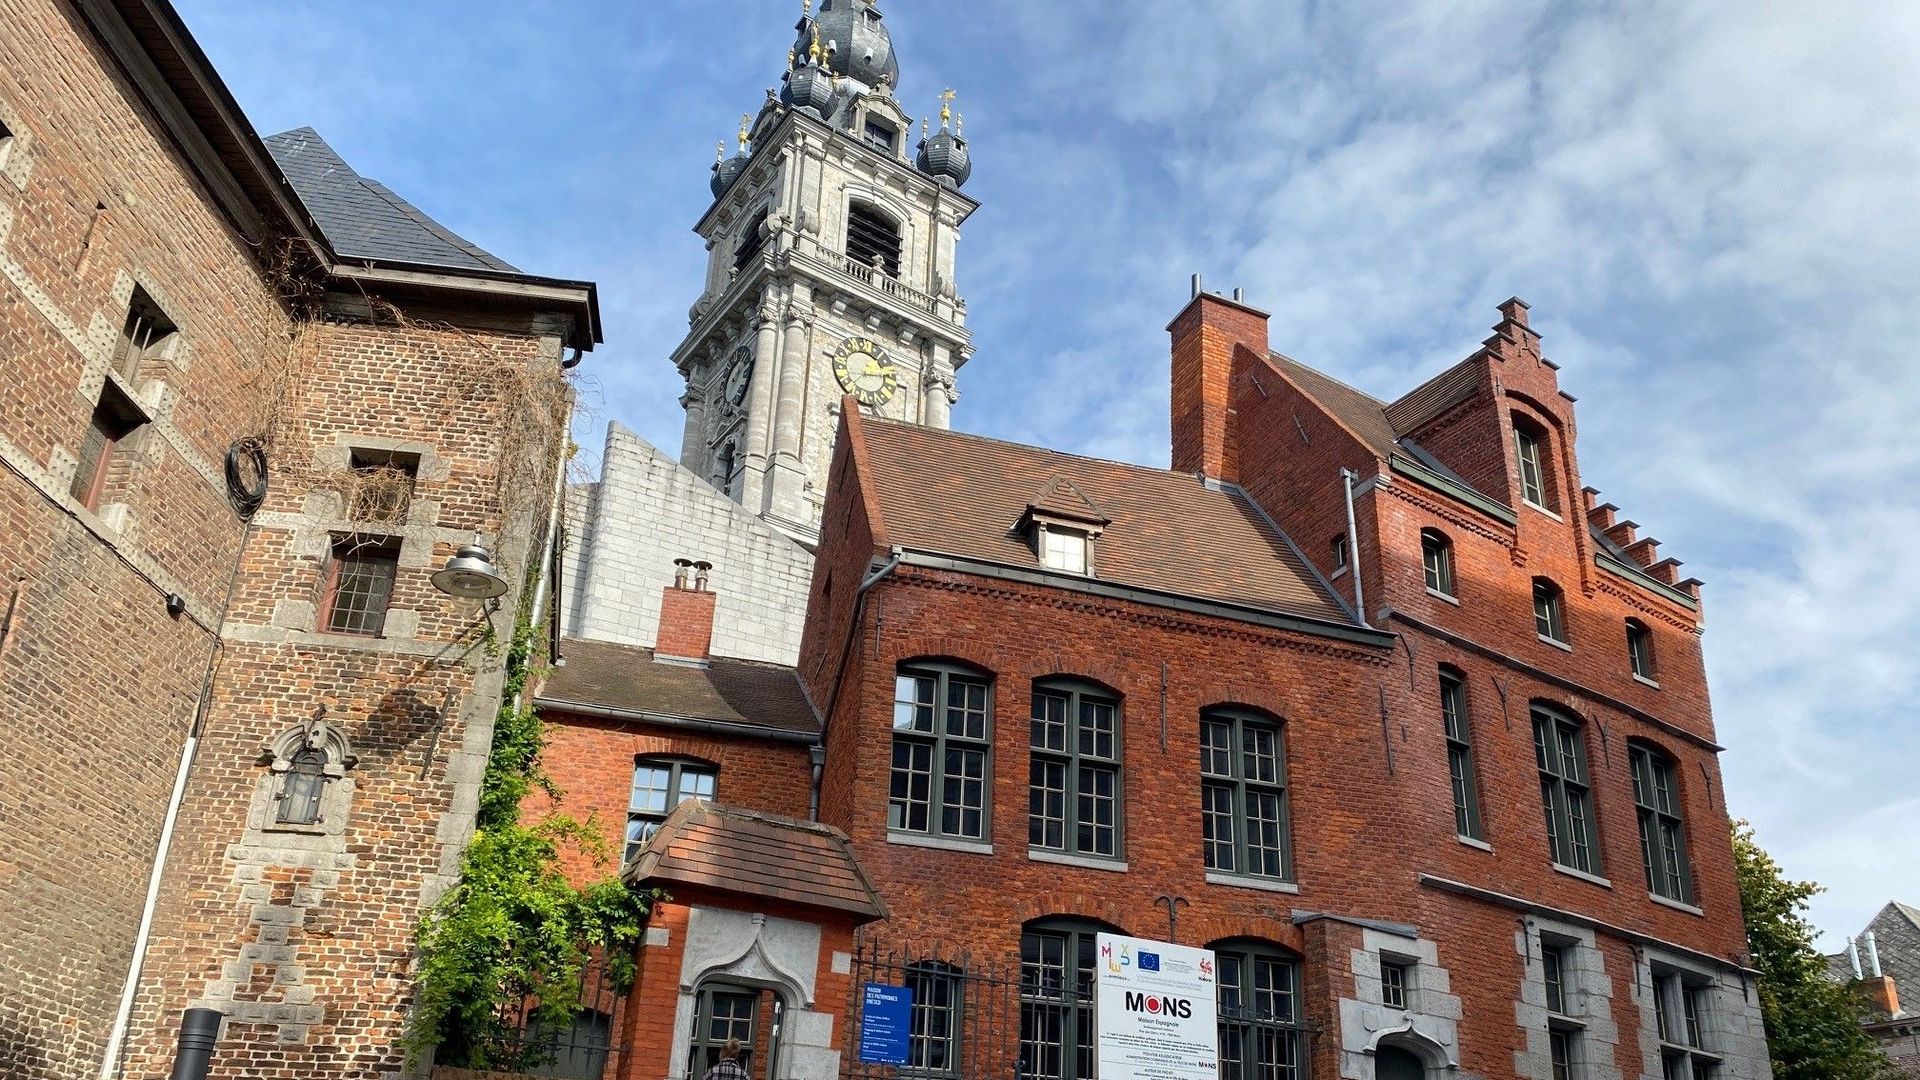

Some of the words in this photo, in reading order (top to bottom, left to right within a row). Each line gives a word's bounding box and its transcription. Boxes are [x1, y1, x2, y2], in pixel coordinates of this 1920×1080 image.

[1125, 991, 1191, 1019] MONS
[1155, 1019, 1179, 1027] Espagnole
[1198, 1061, 1216, 1069] MONS
